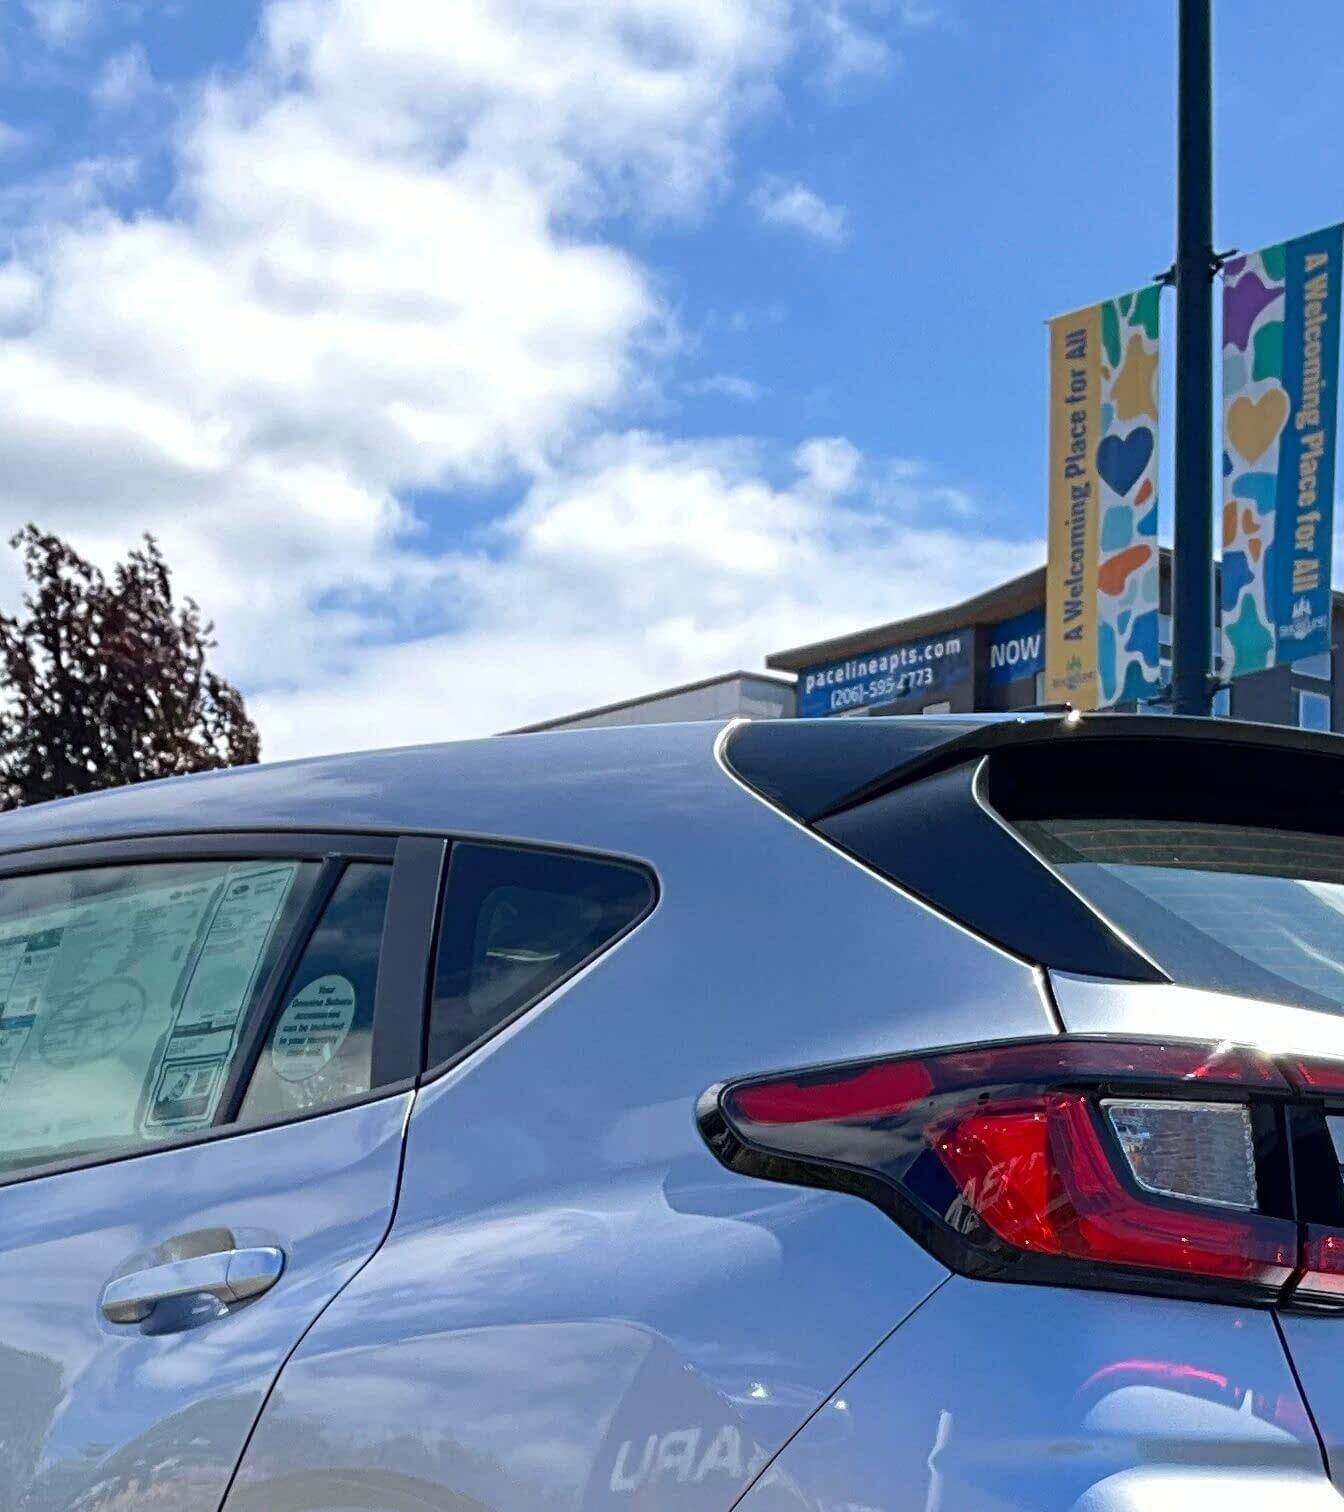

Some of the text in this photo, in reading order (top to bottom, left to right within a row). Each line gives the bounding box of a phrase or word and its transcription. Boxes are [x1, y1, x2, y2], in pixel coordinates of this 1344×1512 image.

[1304, 252, 1328, 272] A
[1297, 273, 1328, 430] Welcoming
[1063, 328, 1090, 641] A Welcoming Place for All
[1298, 431, 1324, 506] Place
[1295, 510, 1321, 550] for
[1291, 559, 1319, 593] All
[806, 637, 961, 694] pacelineapts.com
[990, 633, 1041, 668] NOW
